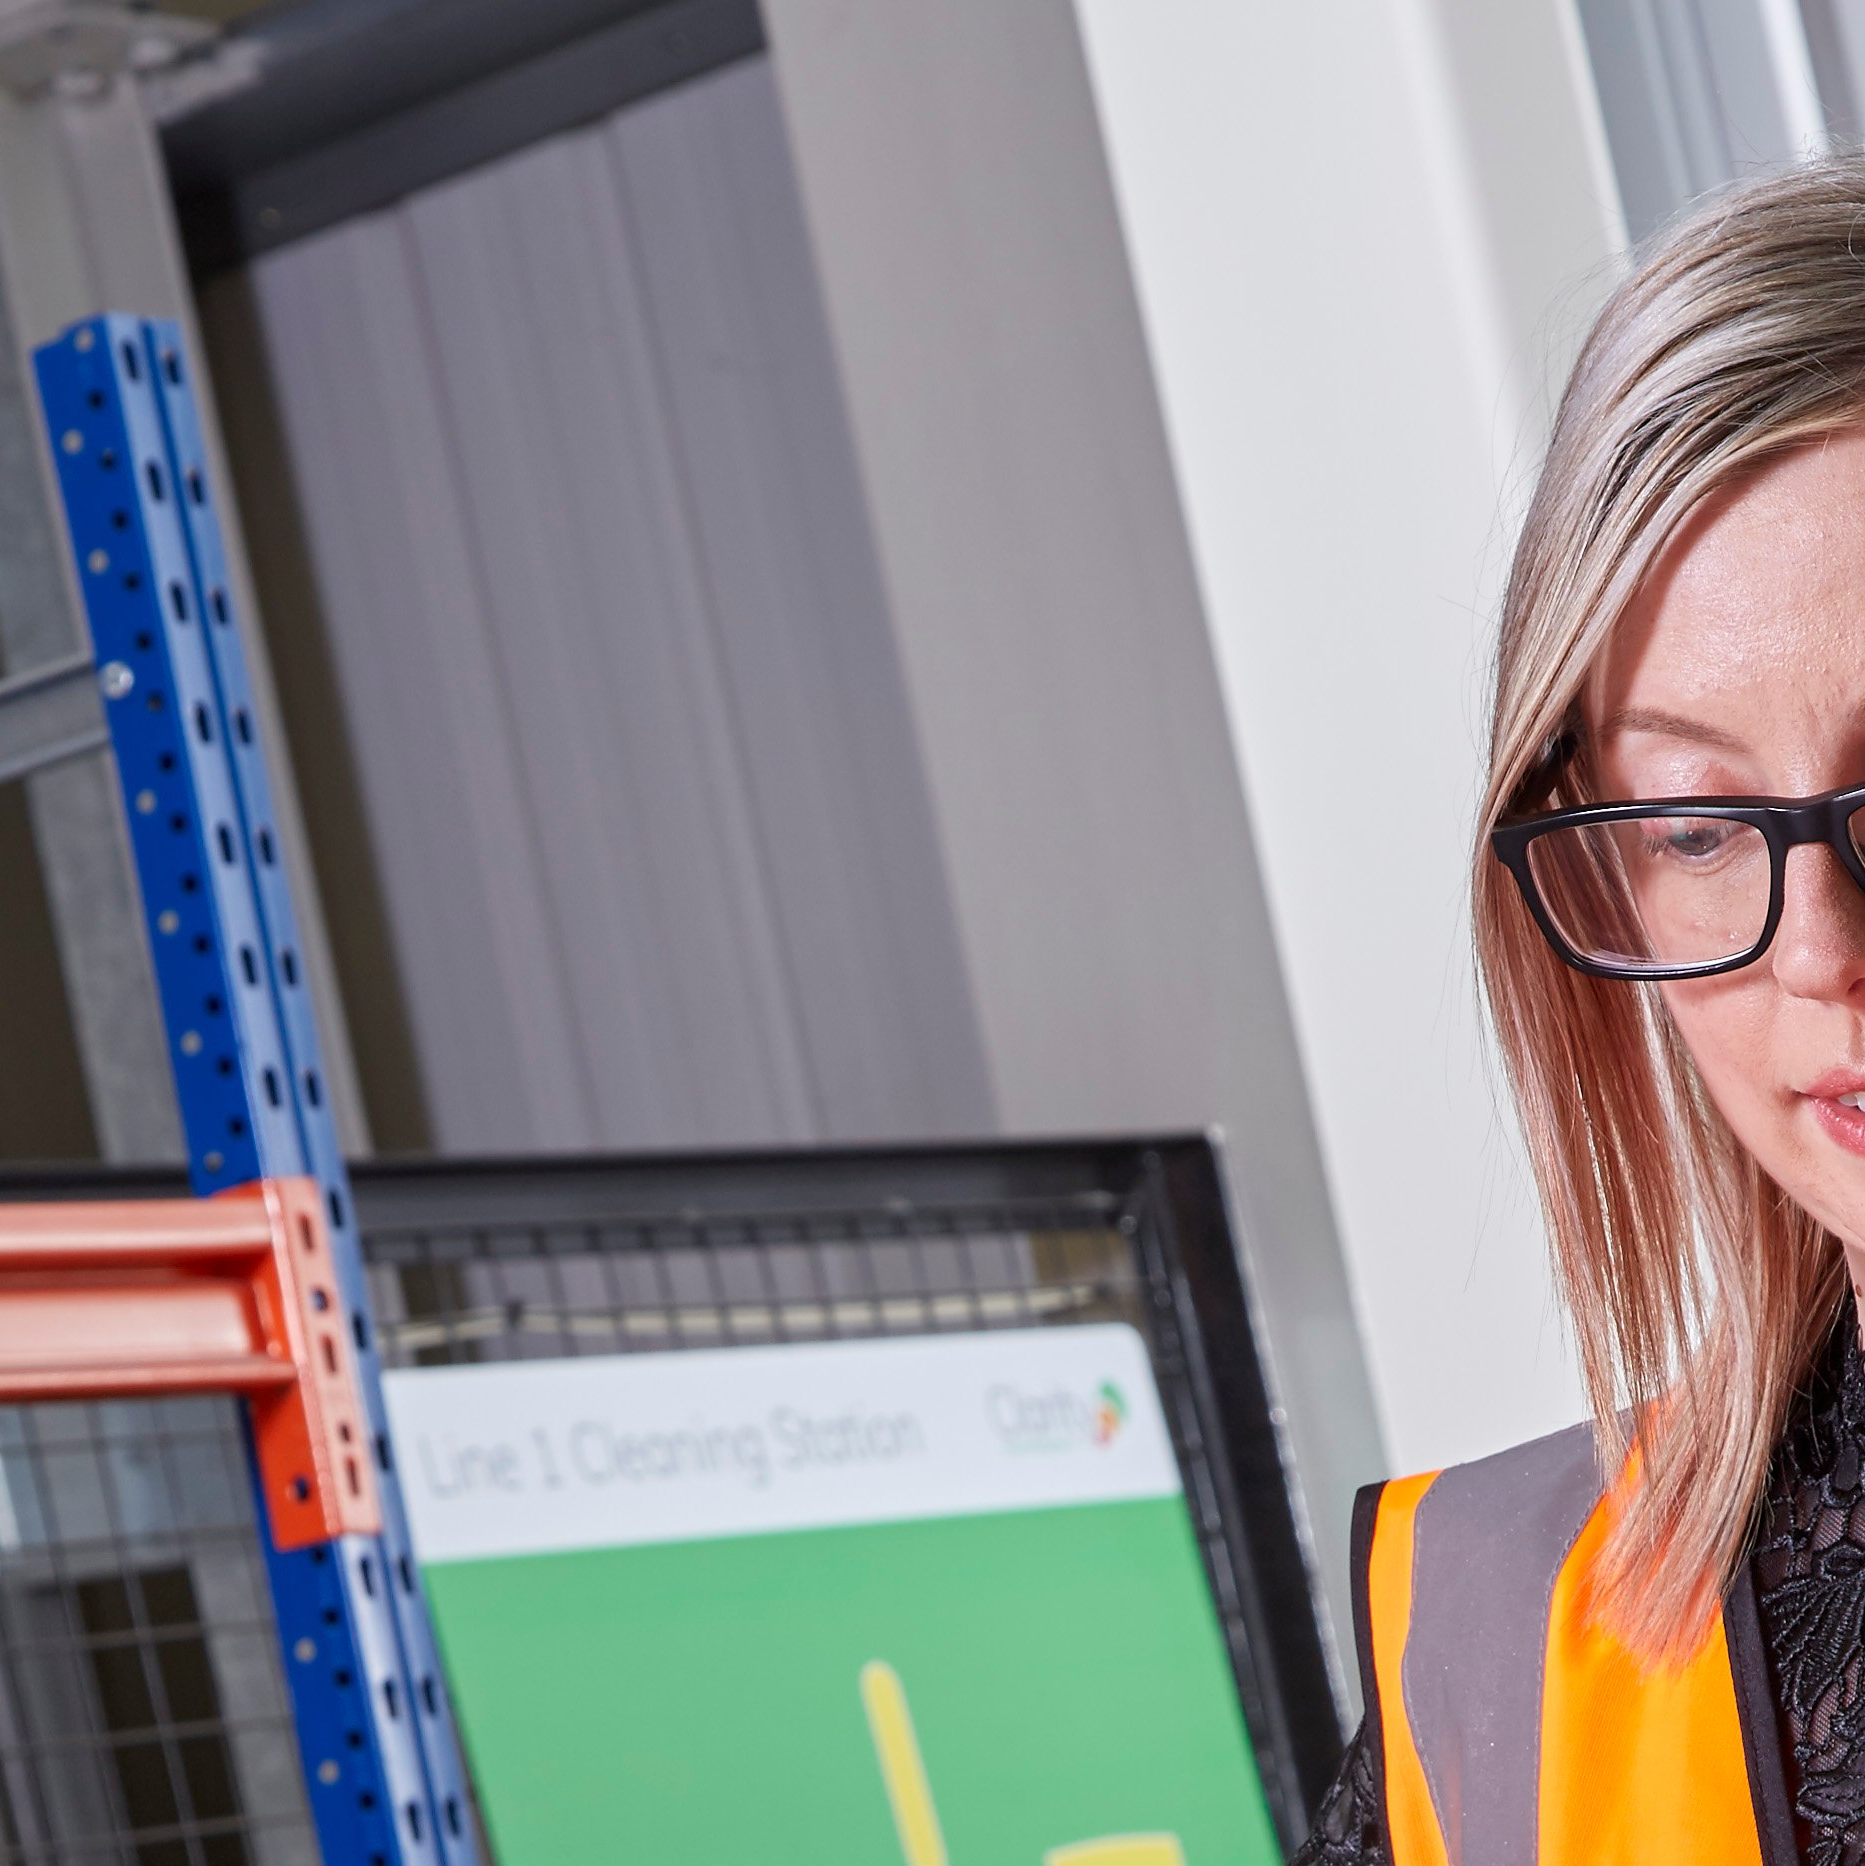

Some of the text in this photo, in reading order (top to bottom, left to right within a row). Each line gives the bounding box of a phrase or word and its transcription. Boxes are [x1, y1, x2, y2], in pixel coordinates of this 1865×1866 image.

[417, 1404, 927, 1499] Line 1 Cleaning Station
